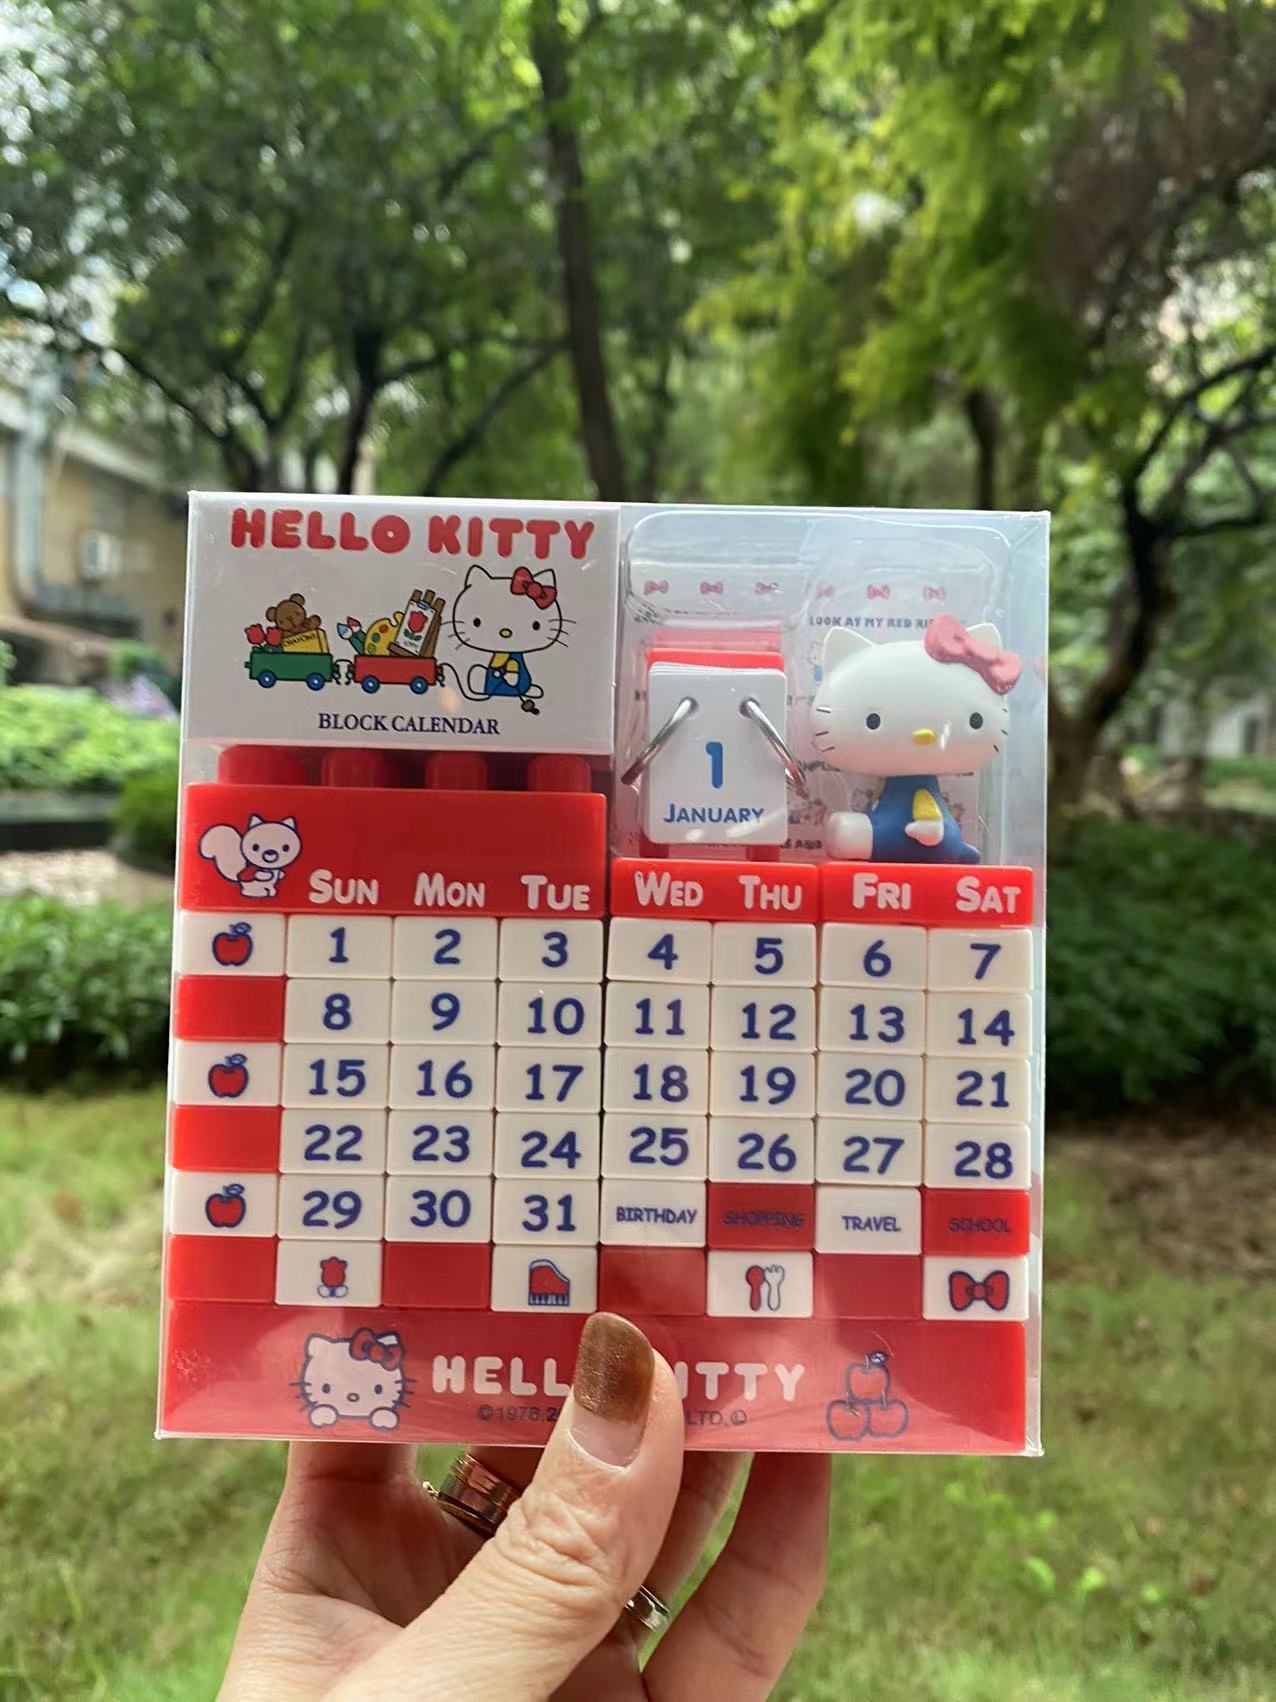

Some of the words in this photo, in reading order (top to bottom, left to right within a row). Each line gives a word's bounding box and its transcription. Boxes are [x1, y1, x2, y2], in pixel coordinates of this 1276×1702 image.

[229, 507, 411, 554] HELLO
[428, 514, 596, 560] KITTY
[809, 615, 842, 627] LOOK
[318, 712, 388, 733] BLOCK
[391, 715, 501, 736] CALENDAR
[704, 740, 724, 789] 1
[663, 803, 766, 825] JANUARY
[308, 868, 379, 904] SUN
[413, 872, 486, 907] MON
[520, 874, 591, 911] TUE
[634, 871, 704, 908] WED
[738, 875, 803, 911] THU
[852, 872, 912, 911] FRI
[956, 875, 1022, 914] SAT
[330, 927, 348, 964] 1
[432, 927, 462, 966] 2
[542, 930, 568, 968] 3
[647, 934, 678, 970] 4
[754, 936, 784, 975] 5
[862, 939, 892, 978] 6
[971, 942, 1000, 980] 7
[322, 992, 352, 1031] 8
[430, 991, 461, 1032] 9
[528, 997, 585, 1036] 10
[635, 998, 683, 1036] 11
[742, 1002, 797, 1041] 12
[849, 1003, 906, 1044] 13
[959, 1008, 1015, 1045] 14
[309, 1058, 367, 1098] 15
[416, 1059, 474, 1100] 16
[527, 1063, 583, 1103] 17
[633, 1063, 689, 1103] 18
[740, 1065, 797, 1105] 19
[844, 1067, 906, 1108] 20
[955, 1070, 1009, 1108] 21
[303, 1123, 364, 1162] 22
[411, 1124, 471, 1164] 23
[520, 1130, 582, 1169] 24
[628, 1126, 689, 1167] 25
[737, 1132, 798, 1173] 26
[842, 1135, 904, 1175] 27
[954, 1140, 1014, 1180] 28
[302, 1189, 362, 1229] 29
[410, 1189, 472, 1229] 30
[521, 1193, 575, 1233] 31
[615, 1206, 697, 1226] BIRTHDAY
[723, 1210, 806, 1229] SHOPPING
[841, 1214, 901, 1233] TRAVEL
[949, 1217, 1011, 1234] SCHOOL
[432, 1354, 572, 1397] HELL
[674, 1361, 805, 1402] ITTY
